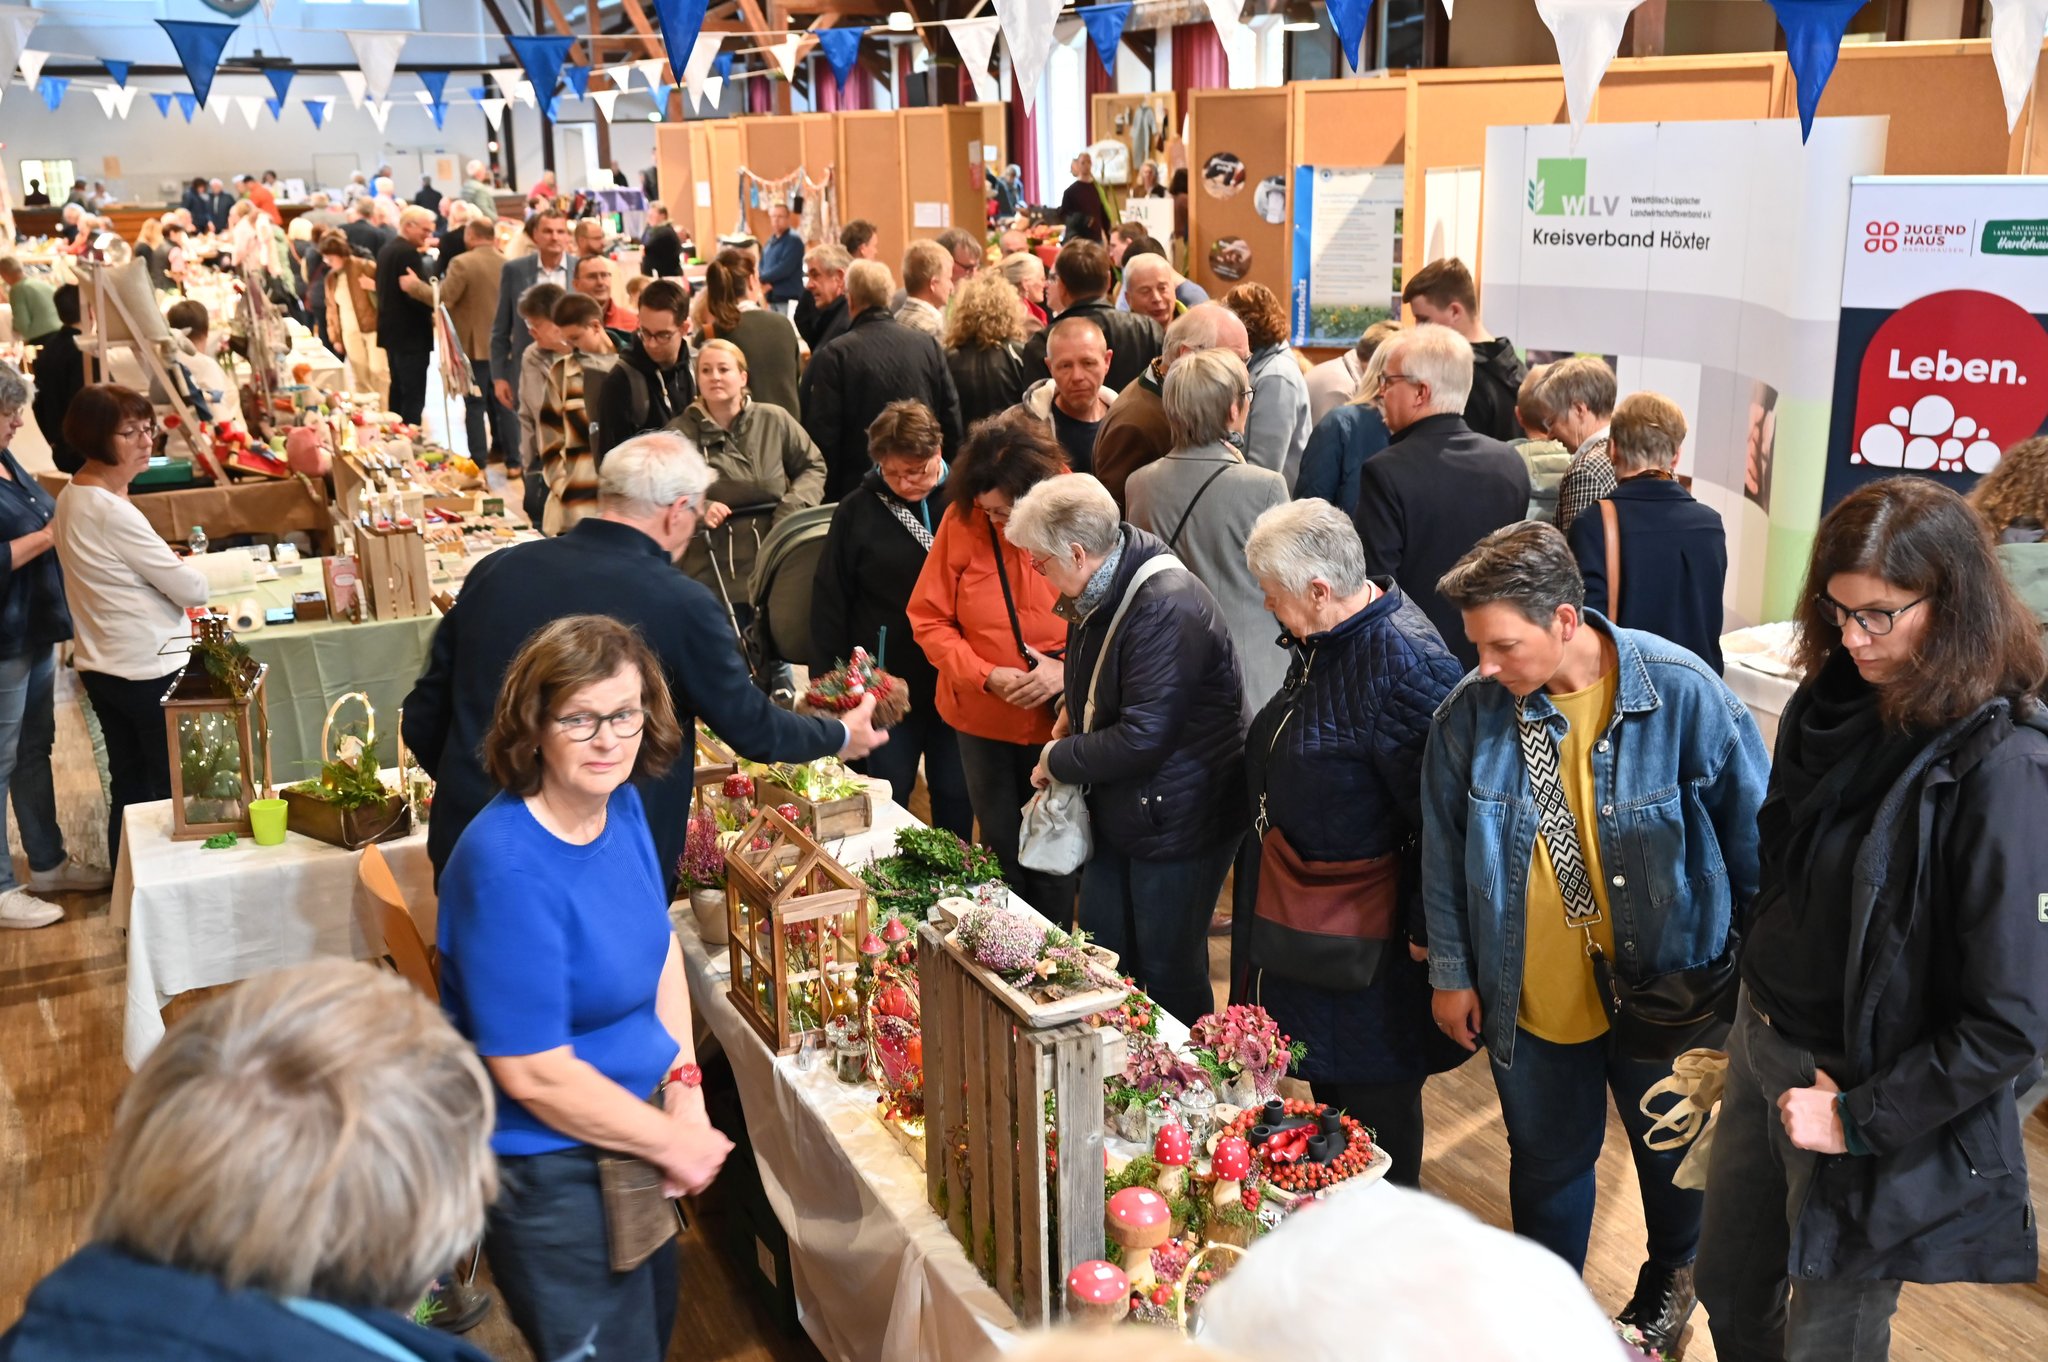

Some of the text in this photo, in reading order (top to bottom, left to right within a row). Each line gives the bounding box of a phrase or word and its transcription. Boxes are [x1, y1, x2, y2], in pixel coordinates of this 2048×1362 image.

[1562, 196, 1620, 216] WLV
[1533, 228, 1710, 251] Kreisverband Höxter
[1904, 224, 1967, 236] JUGEND
[1904, 235, 1946, 246] HAUS
[1888, 348, 2027, 385] Leben.
